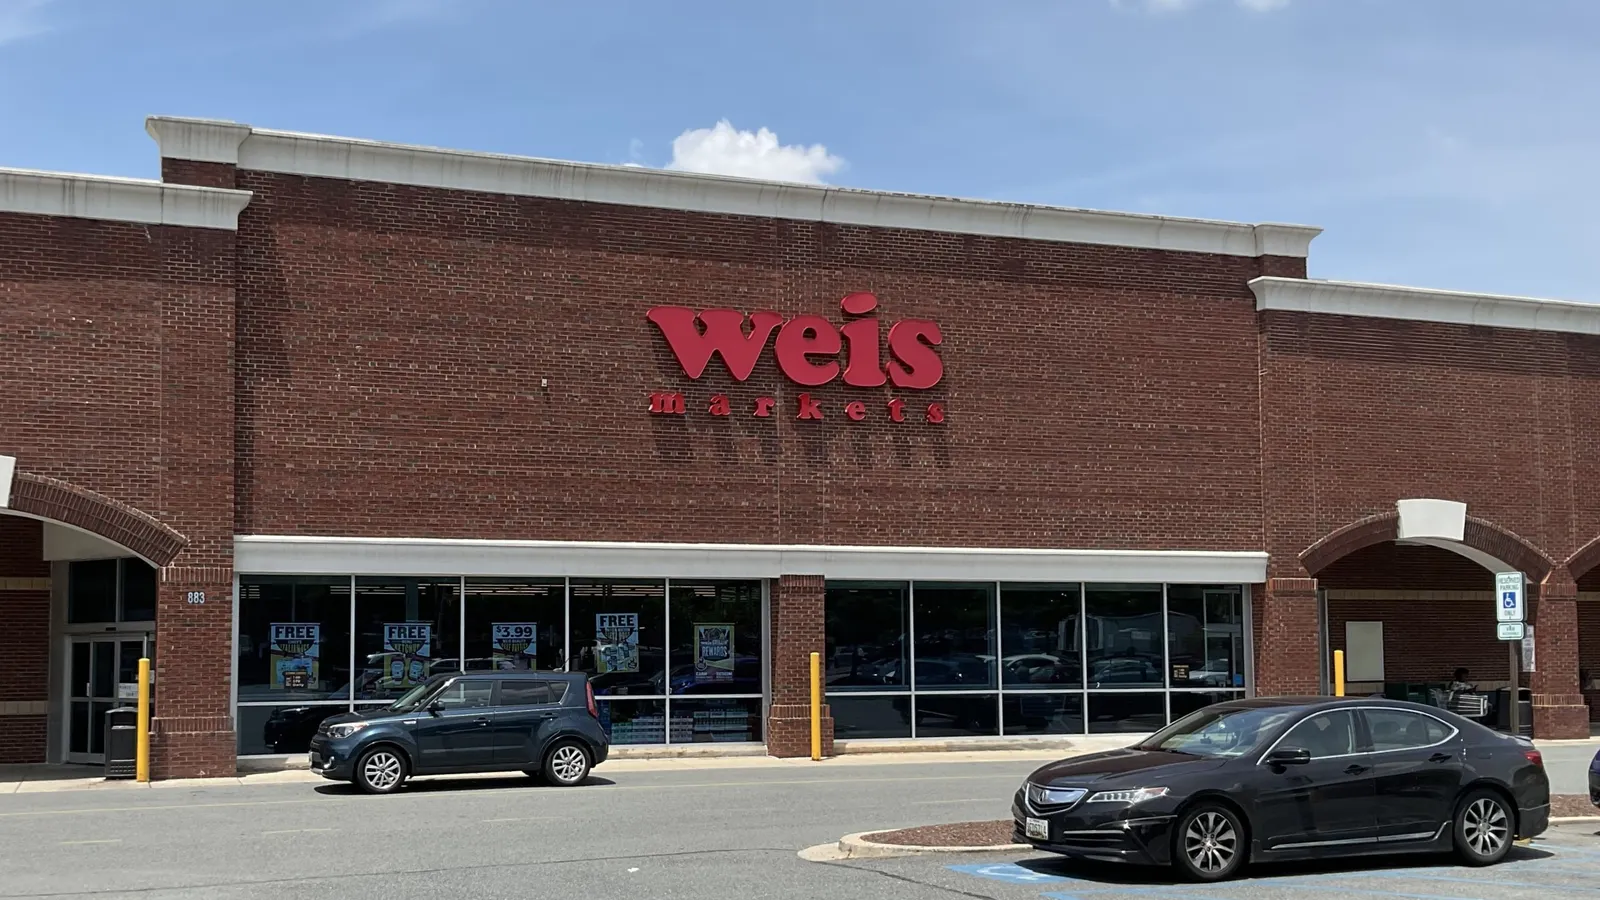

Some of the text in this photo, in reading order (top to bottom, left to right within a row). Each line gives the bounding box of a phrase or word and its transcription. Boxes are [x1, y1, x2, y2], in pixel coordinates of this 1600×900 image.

[646, 291, 944, 390] weis
[648, 392, 946, 423] markets
[187, 591, 205, 604] 883
[600, 615, 635, 627] FREE
[275, 626, 315, 639] FREE
[388, 626, 426, 639] FREE
[496, 625, 533, 638] $3.99
[702, 645, 728, 658] REWARDS
